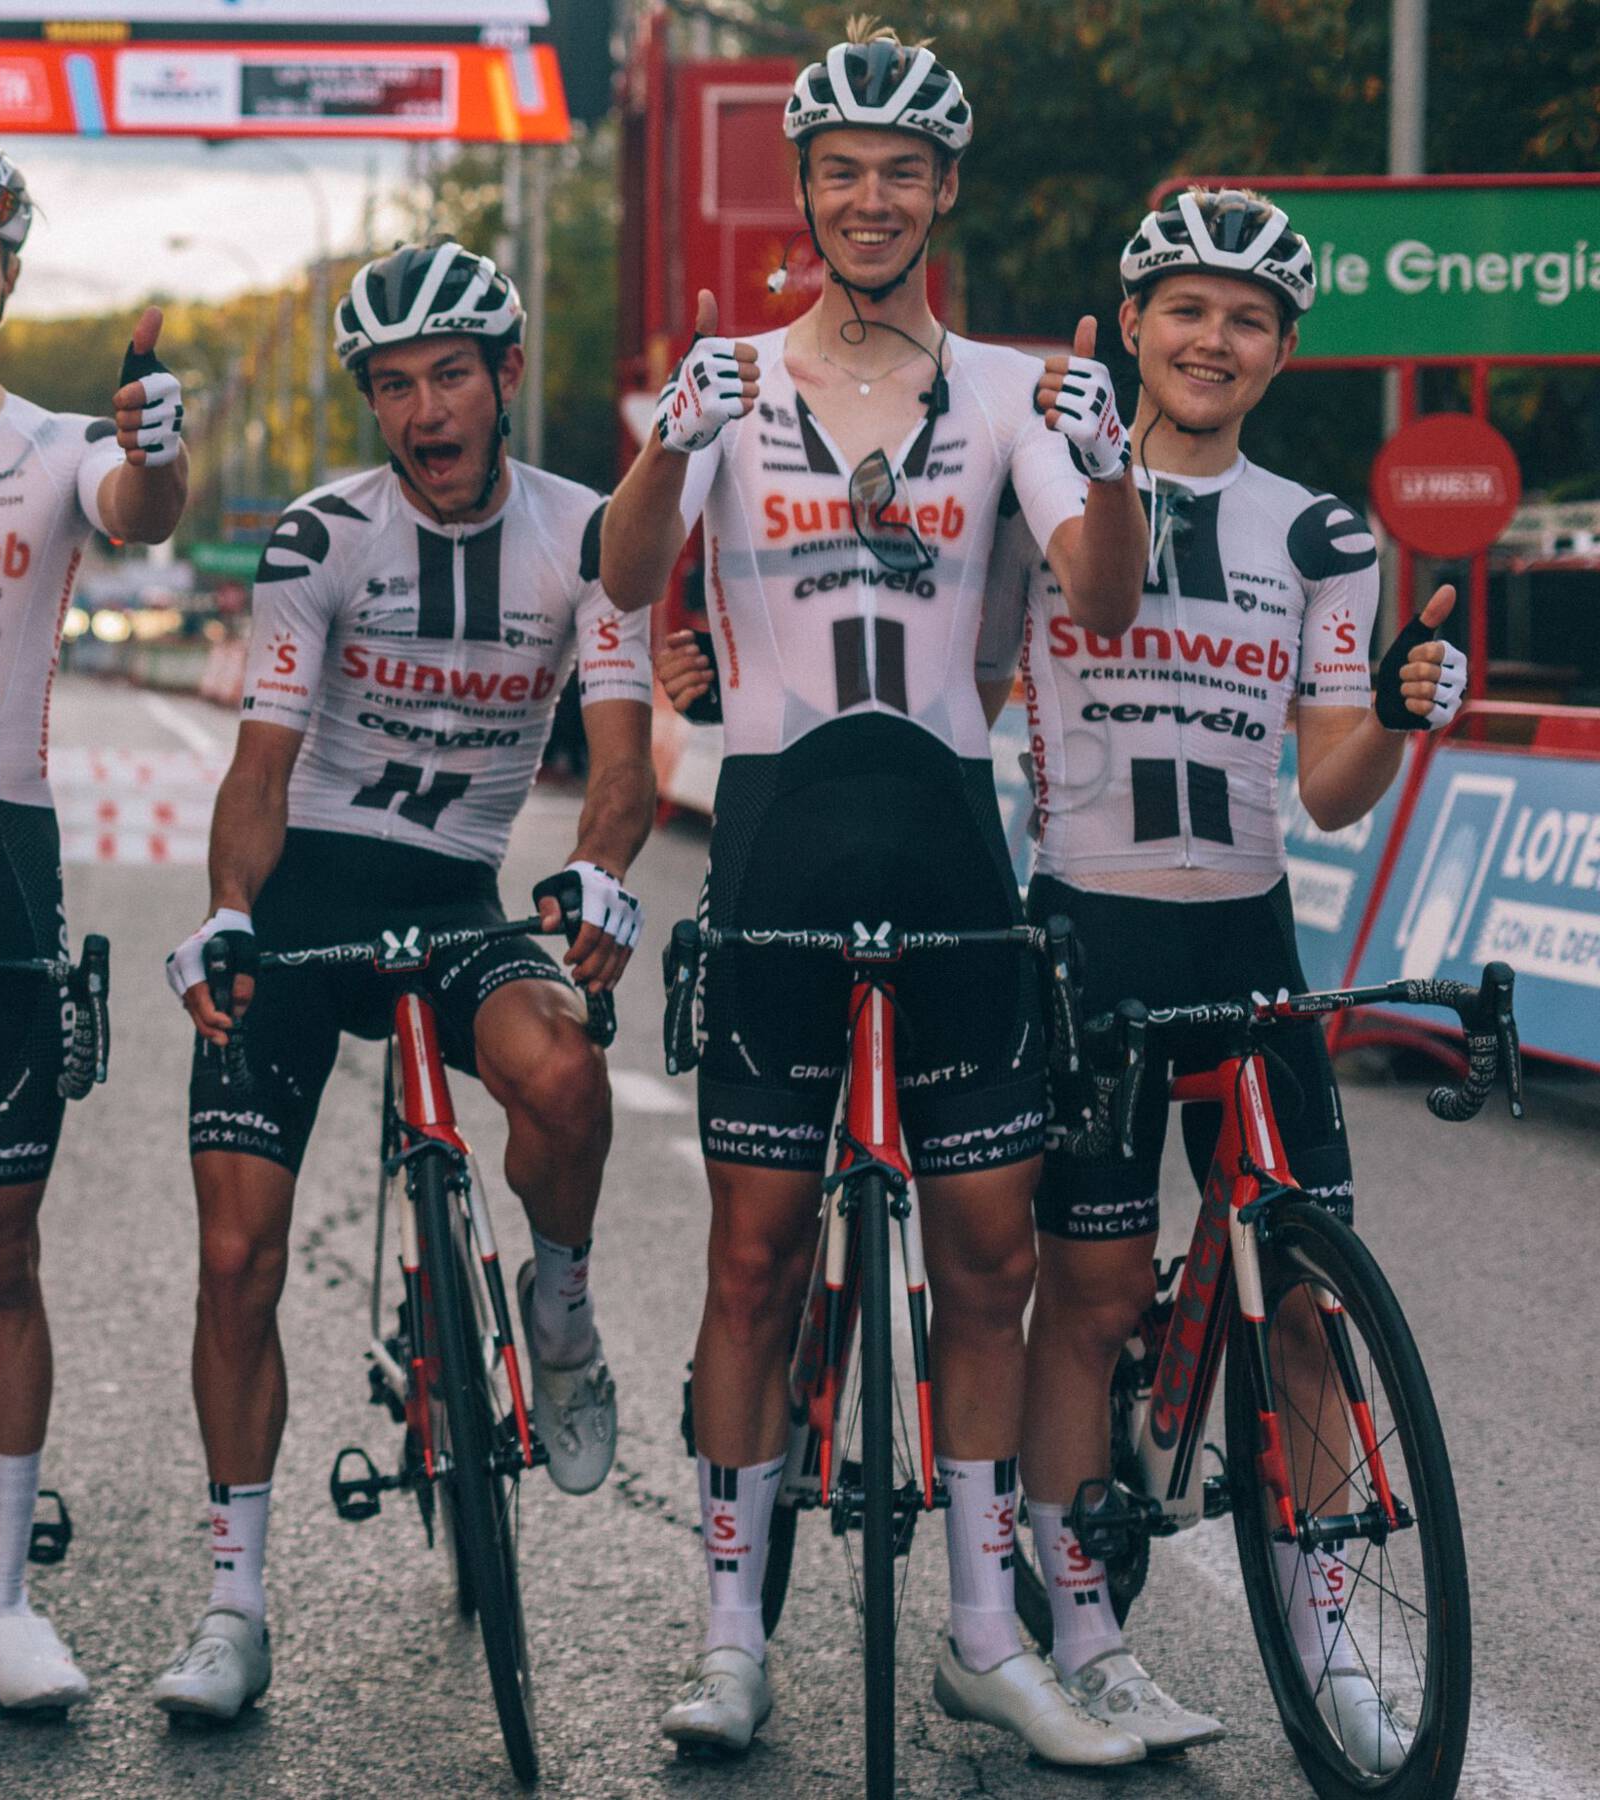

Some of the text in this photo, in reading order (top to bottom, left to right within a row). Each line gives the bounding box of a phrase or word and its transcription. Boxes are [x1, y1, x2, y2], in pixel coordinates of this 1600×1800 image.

[791, 109, 830, 128] LAZER
[907, 113, 956, 137] LAZER
[1138, 250, 1184, 270] LAZER
[1264, 261, 1307, 293] LAZER
[431, 318, 487, 329] LAZER
[765, 494, 965, 541] Sunweb
[794, 567, 937, 600] cervélo
[1229, 571, 1275, 588] CRAFT
[1261, 602, 1287, 615] DSM
[1050, 615, 1290, 682] Sunweb
[342, 645, 555, 702] Sunweb
[1080, 667, 1268, 701] #CREATINGMEMORIES
[357, 713, 521, 747] cervélo
[1082, 701, 1266, 741] cervélo
[1502, 806, 1600, 888] LOTE
[791, 1065, 840, 1080] CRAF
[903, 1067, 956, 1088] RAFT
[710, 1117, 825, 1142] cervélo
[922, 1111, 1043, 1150] cervélo
[707, 1138, 768, 1159] BINCK
[919, 1150, 986, 1169] BINCK
[1068, 1215, 1135, 1234] BINCK
